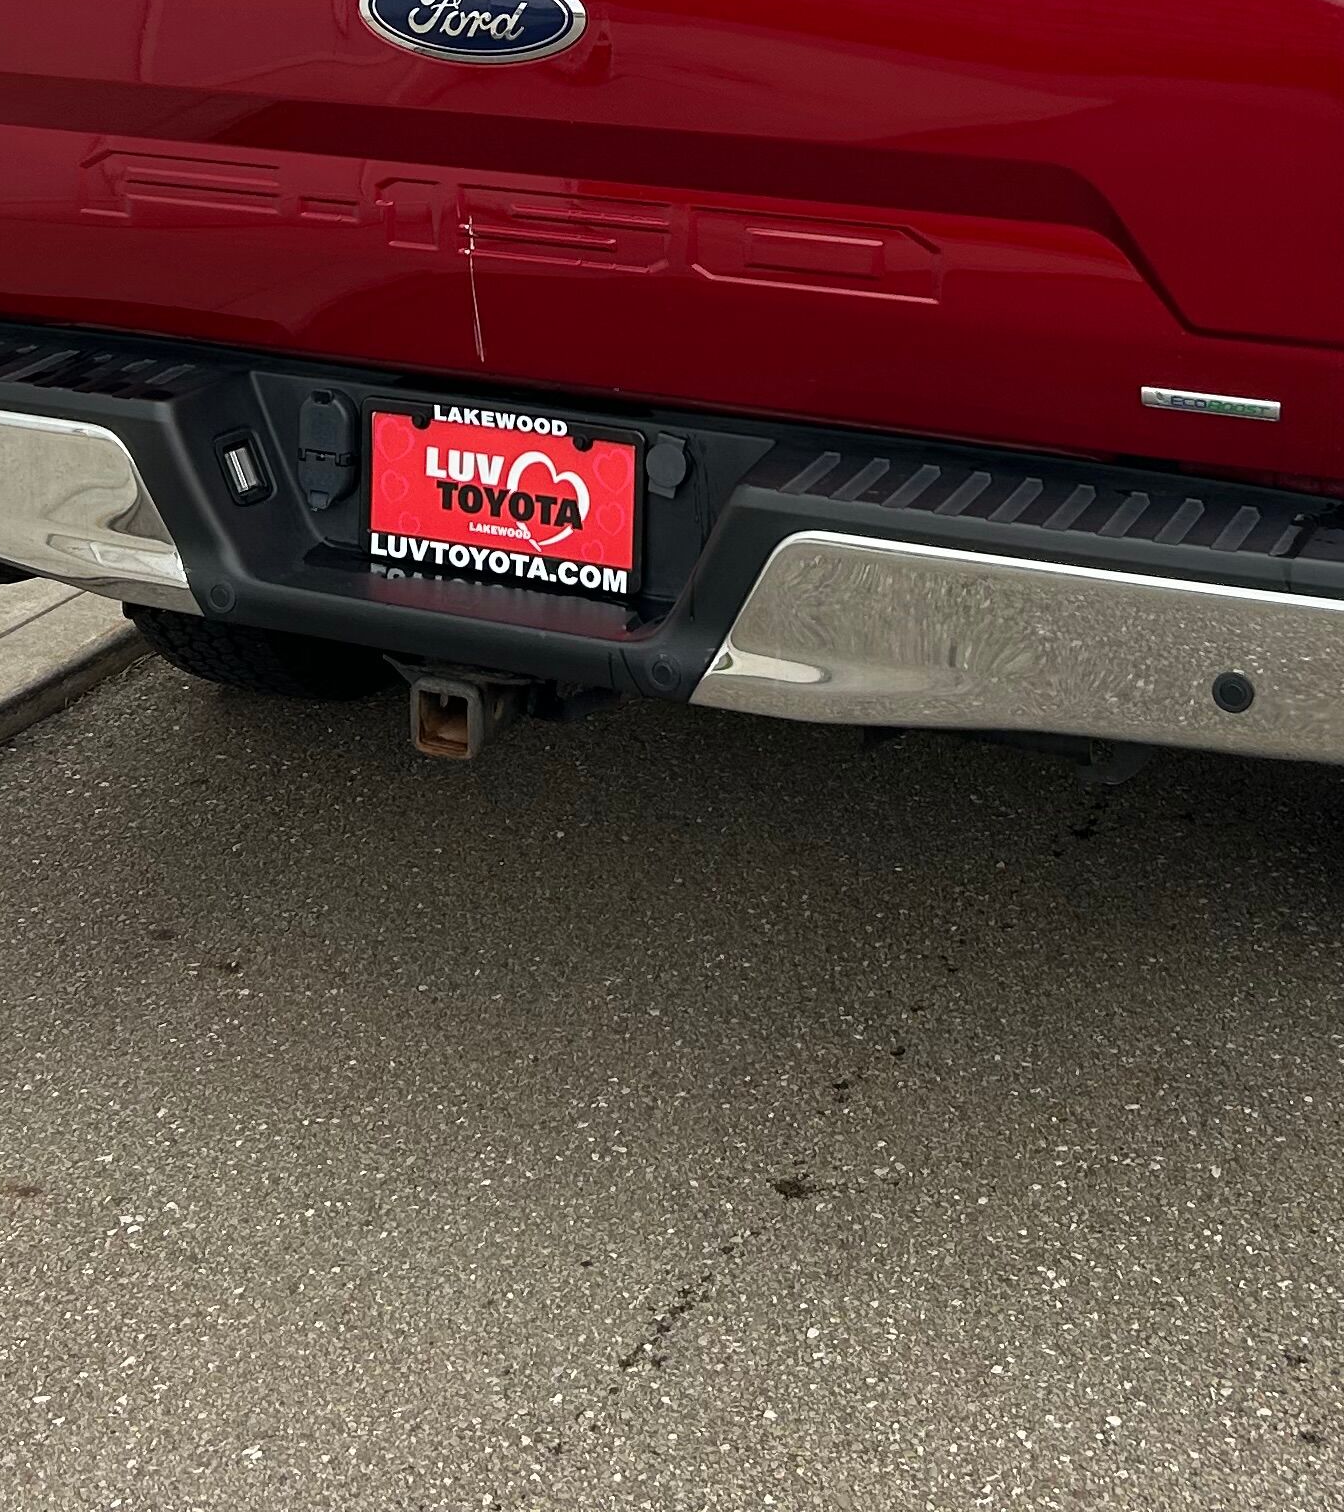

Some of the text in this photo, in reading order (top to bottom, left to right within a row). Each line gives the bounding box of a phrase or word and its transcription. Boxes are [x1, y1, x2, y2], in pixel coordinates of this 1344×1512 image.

[79, 148, 942, 305] F-150
[433, 404, 568, 436] LAKEWOOD
[425, 446, 505, 486] LUV
[436, 481, 583, 530] TOYOTA
[469, 521, 531, 540] LAKEWOOD
[370, 533, 628, 594] LUVTOYOTA.COM
